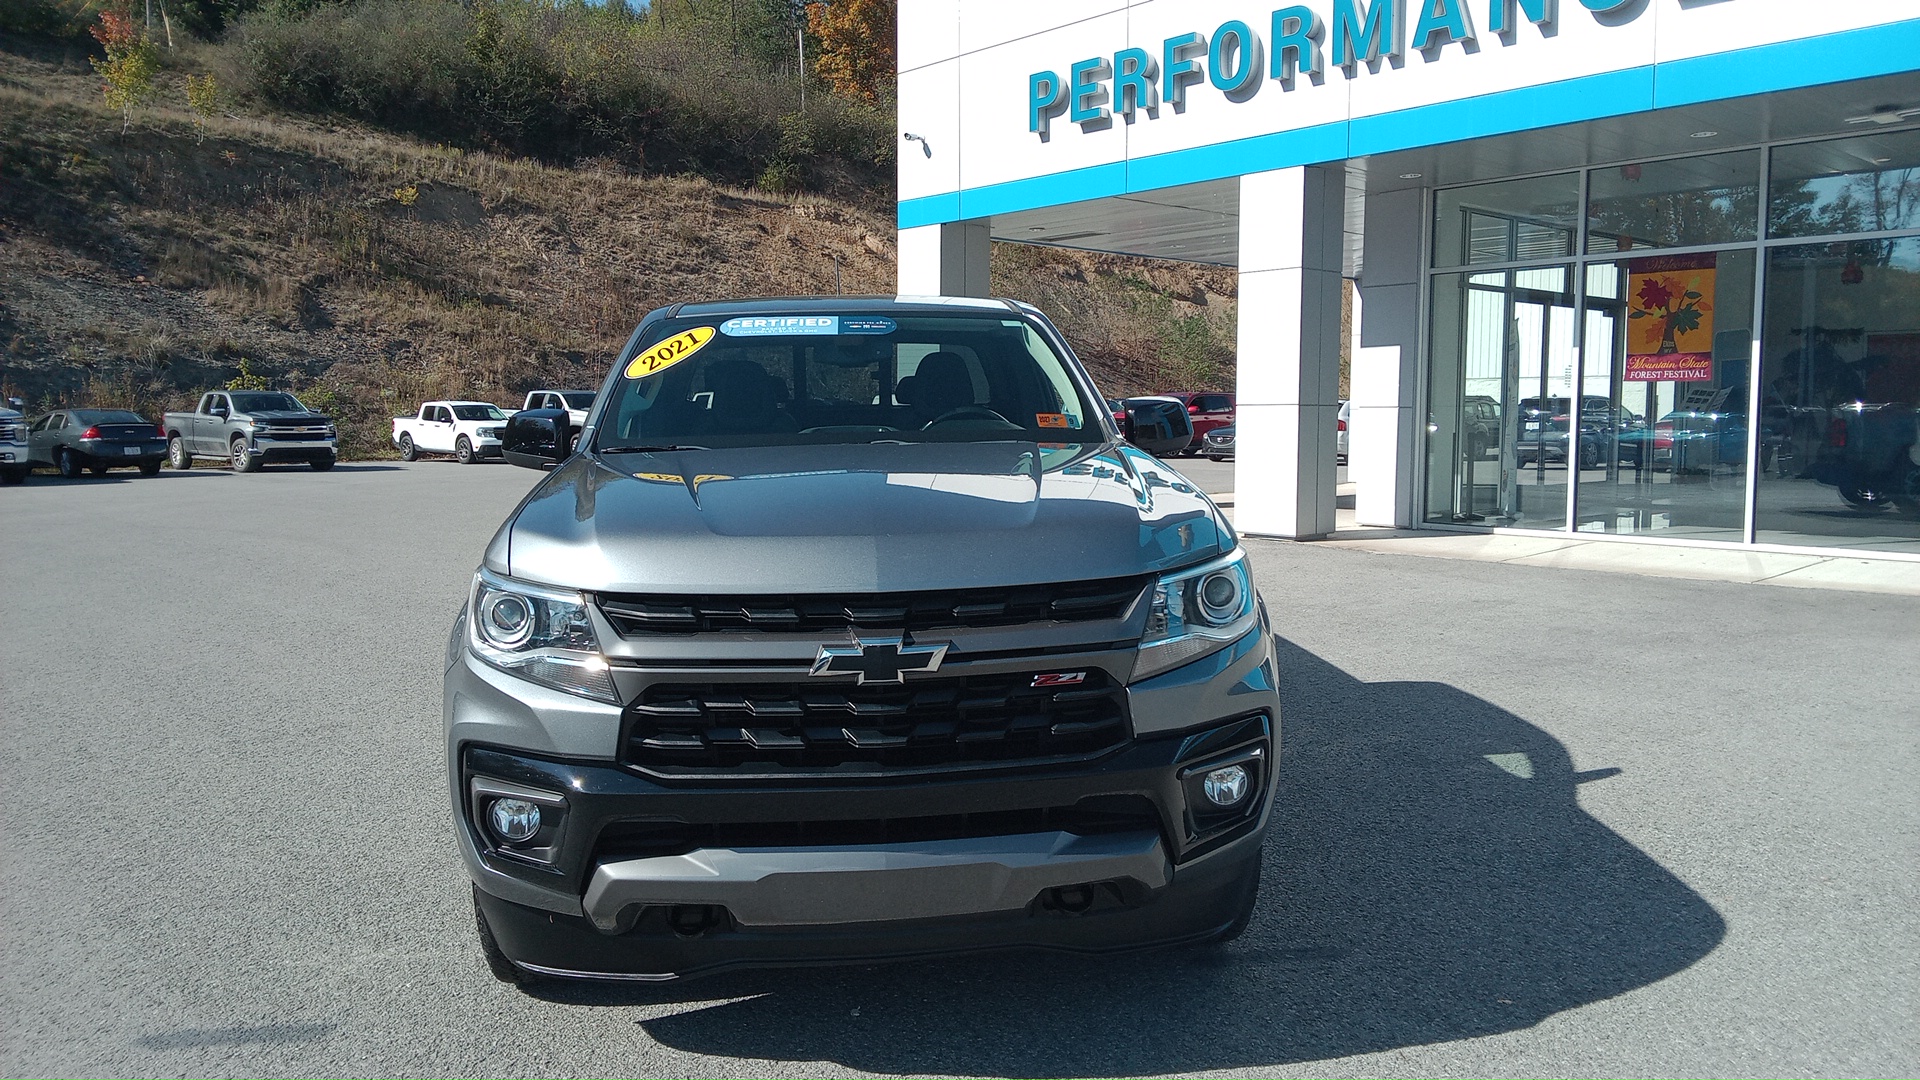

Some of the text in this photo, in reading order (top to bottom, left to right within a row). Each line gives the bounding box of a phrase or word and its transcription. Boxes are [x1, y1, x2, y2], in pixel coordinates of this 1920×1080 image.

[727, 318, 833, 328] CERTIFIED
[642, 332, 702, 371] 2021
[1627, 354, 1709, 370] Mountain State
[1629, 369, 1707, 379] FOREST FESTIVAL
[1030, 672, 1087, 687] Z71
